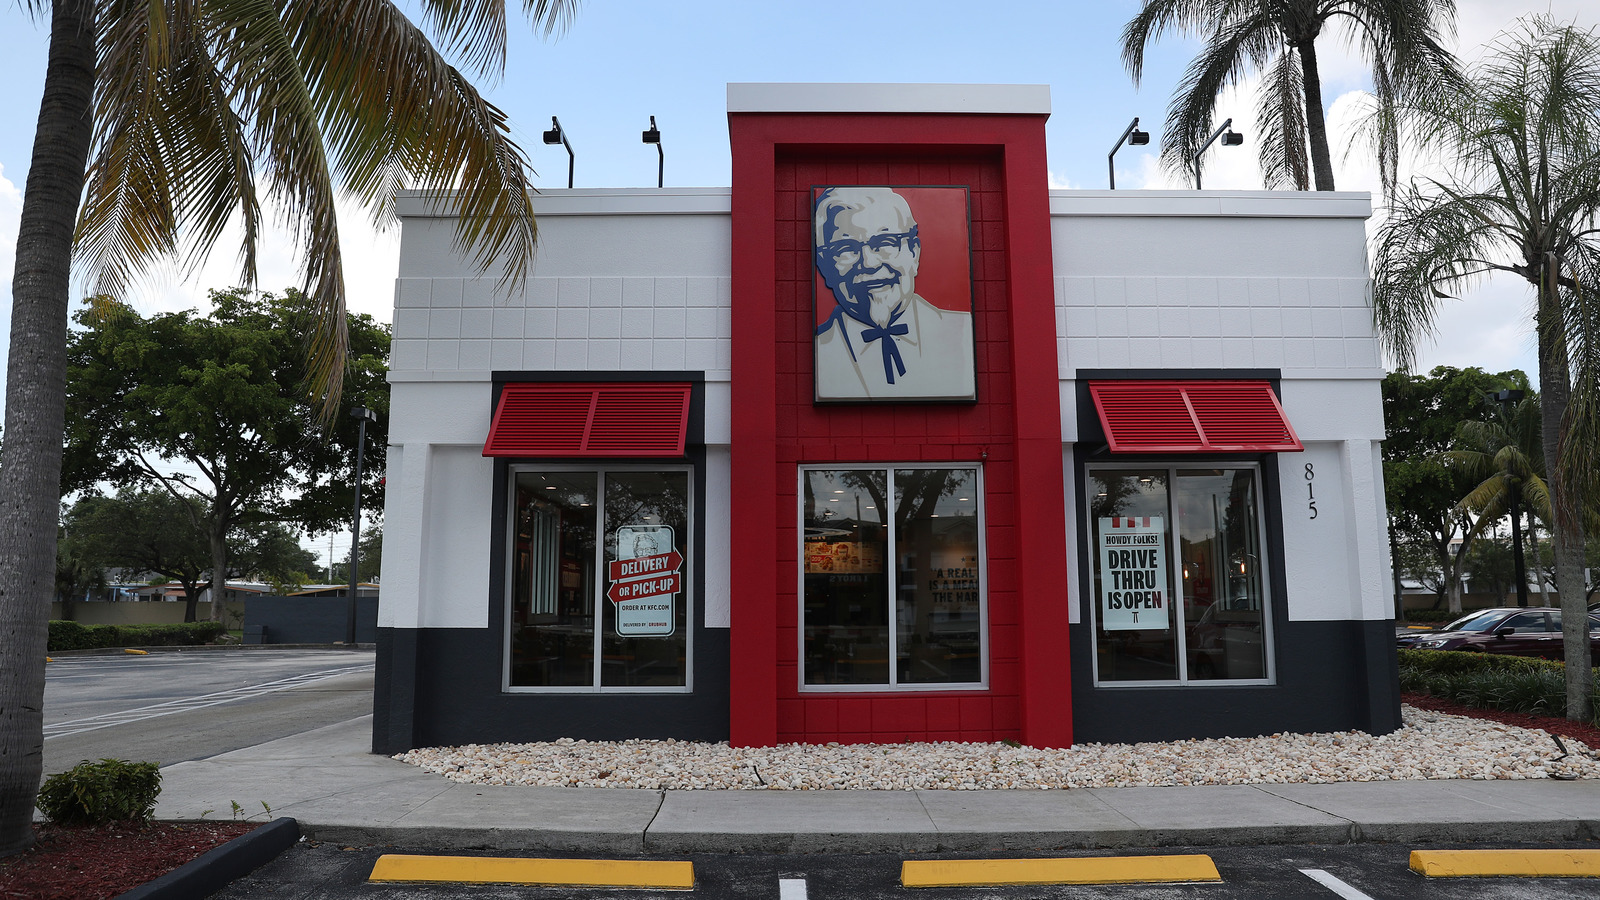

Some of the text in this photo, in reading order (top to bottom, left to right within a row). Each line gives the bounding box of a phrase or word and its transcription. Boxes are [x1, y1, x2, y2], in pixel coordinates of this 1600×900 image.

[1304, 462, 1318, 520] 815
[1106, 535, 1158, 544] HOWDY FOLKS!
[621, 556, 669, 576] DELIVERY
[1108, 549, 1158, 569] DRIVE
[947, 567, 975, 578] REAL
[1111, 570, 1156, 590] THRU
[619, 577, 674, 597] OR PICK-UP
[929, 580, 939, 590] IS
[942, 580, 950, 590] A
[932, 592, 953, 602] THE
[1108, 591, 1162, 610] IS OPEN
